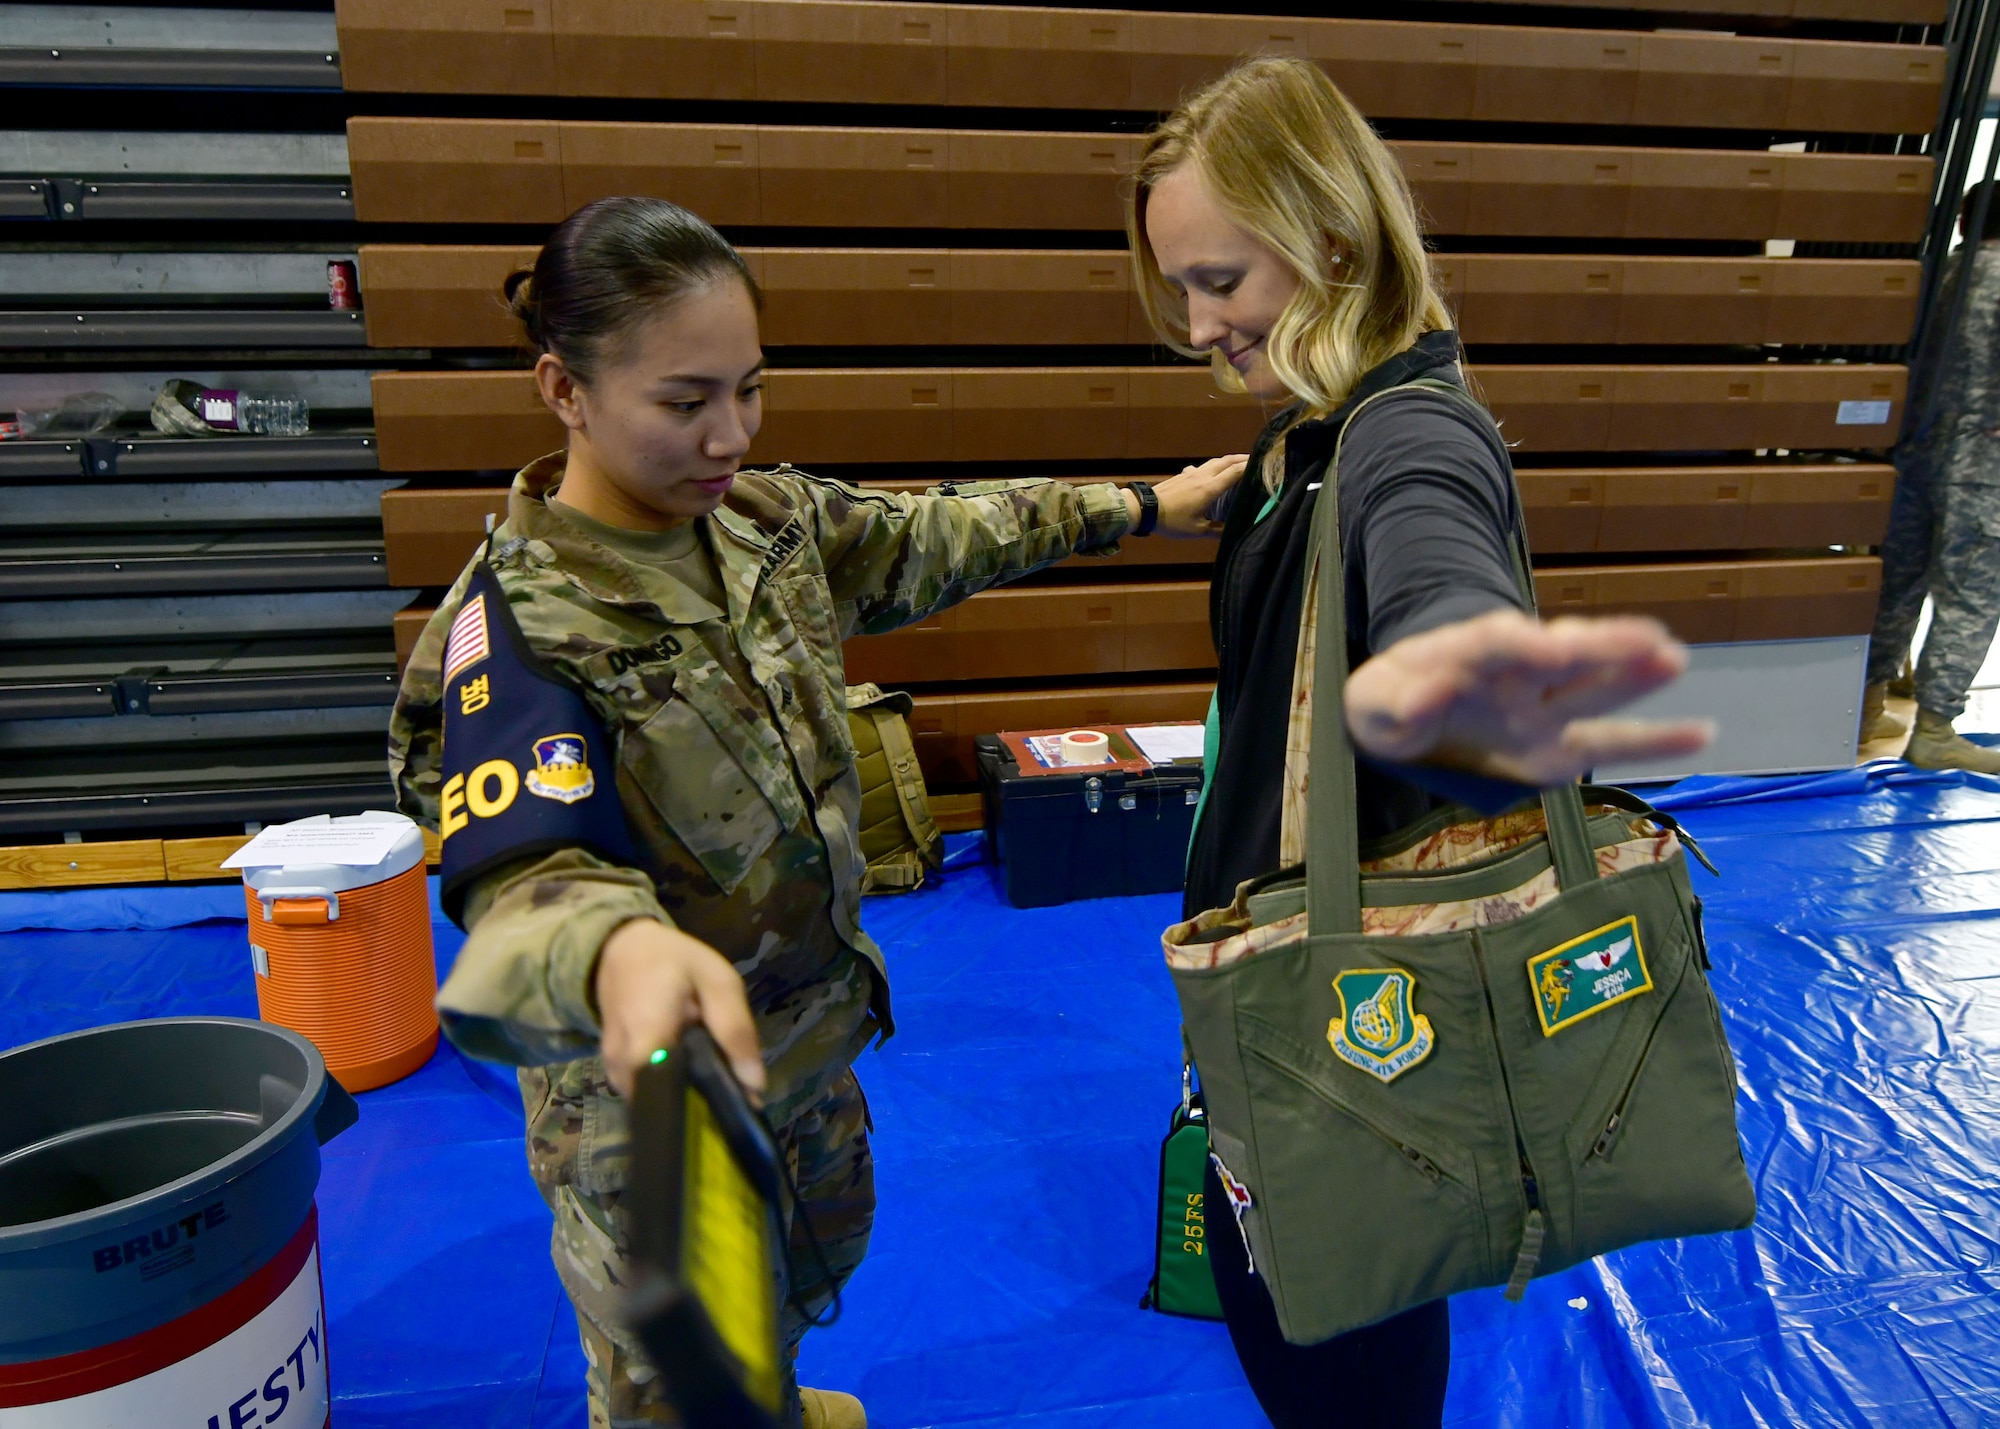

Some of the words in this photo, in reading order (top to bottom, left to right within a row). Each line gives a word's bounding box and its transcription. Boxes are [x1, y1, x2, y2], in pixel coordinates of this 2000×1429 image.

[606, 634, 683, 676] DOGO
[441, 758, 519, 841] EO
[1592, 967, 1632, 994] JESSICA
[1375, 1063, 1397, 1076] AIR
[1395, 1037, 1430, 1067] FORCES
[92, 1200, 229, 1274] BRUTE
[207, 1307, 320, 1429] ESTY
